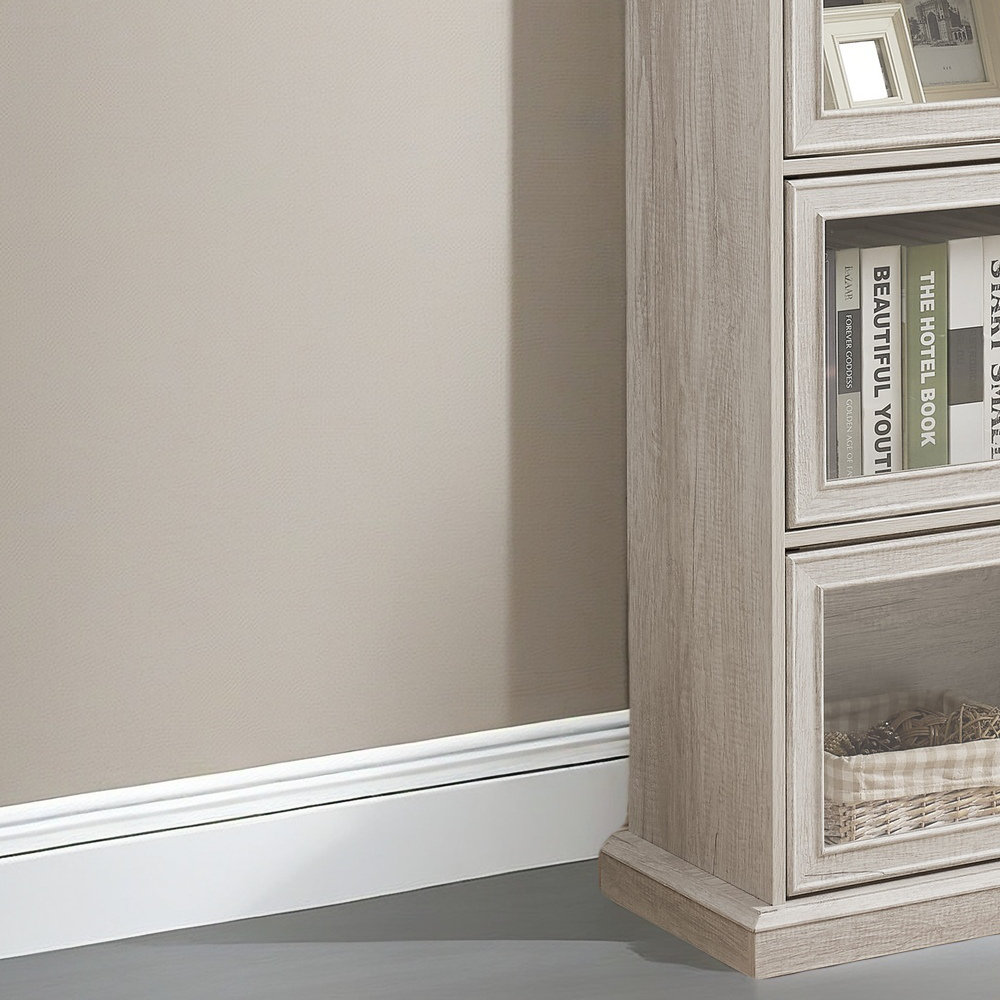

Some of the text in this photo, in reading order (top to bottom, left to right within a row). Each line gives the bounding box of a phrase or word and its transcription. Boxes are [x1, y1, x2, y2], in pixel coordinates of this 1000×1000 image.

[845, 314, 853, 389] FOREVER GODDESS
[873, 265, 892, 398] BEAUTIFUL
[919, 271, 937, 448] THE HOTEL BOOK
[845, 399, 853, 434] GOLDEN
[845, 435, 853, 450] AGE
[845, 452, 853, 465] OF
